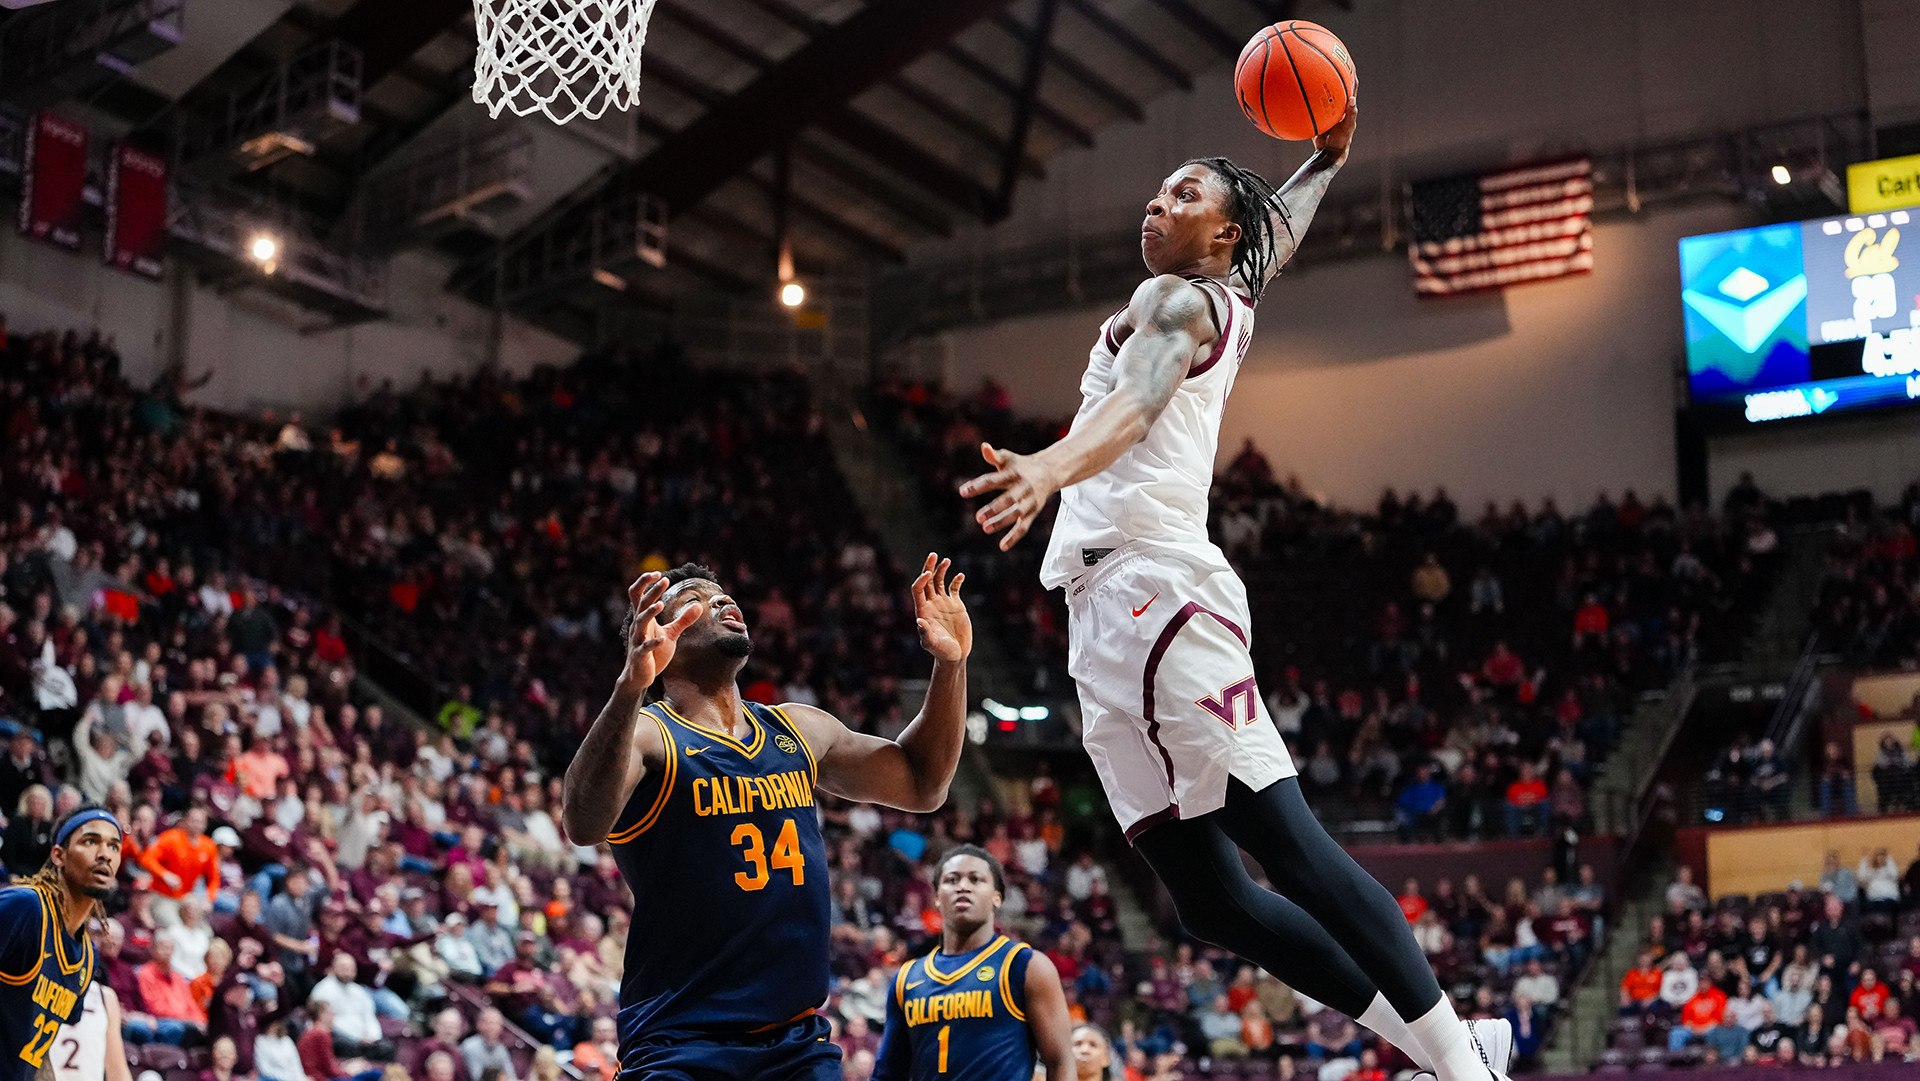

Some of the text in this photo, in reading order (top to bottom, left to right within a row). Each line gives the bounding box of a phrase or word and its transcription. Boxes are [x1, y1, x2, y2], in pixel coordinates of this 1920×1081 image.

[1194, 674, 1258, 731] VT
[692, 770, 815, 817] CALIFORNIA
[730, 819, 805, 891] 34
[904, 990, 993, 1028] CALIFORNIA
[19, 1013, 59, 1069] 22
[62, 1038, 79, 1070] 2
[938, 1025, 950, 1073] 1
